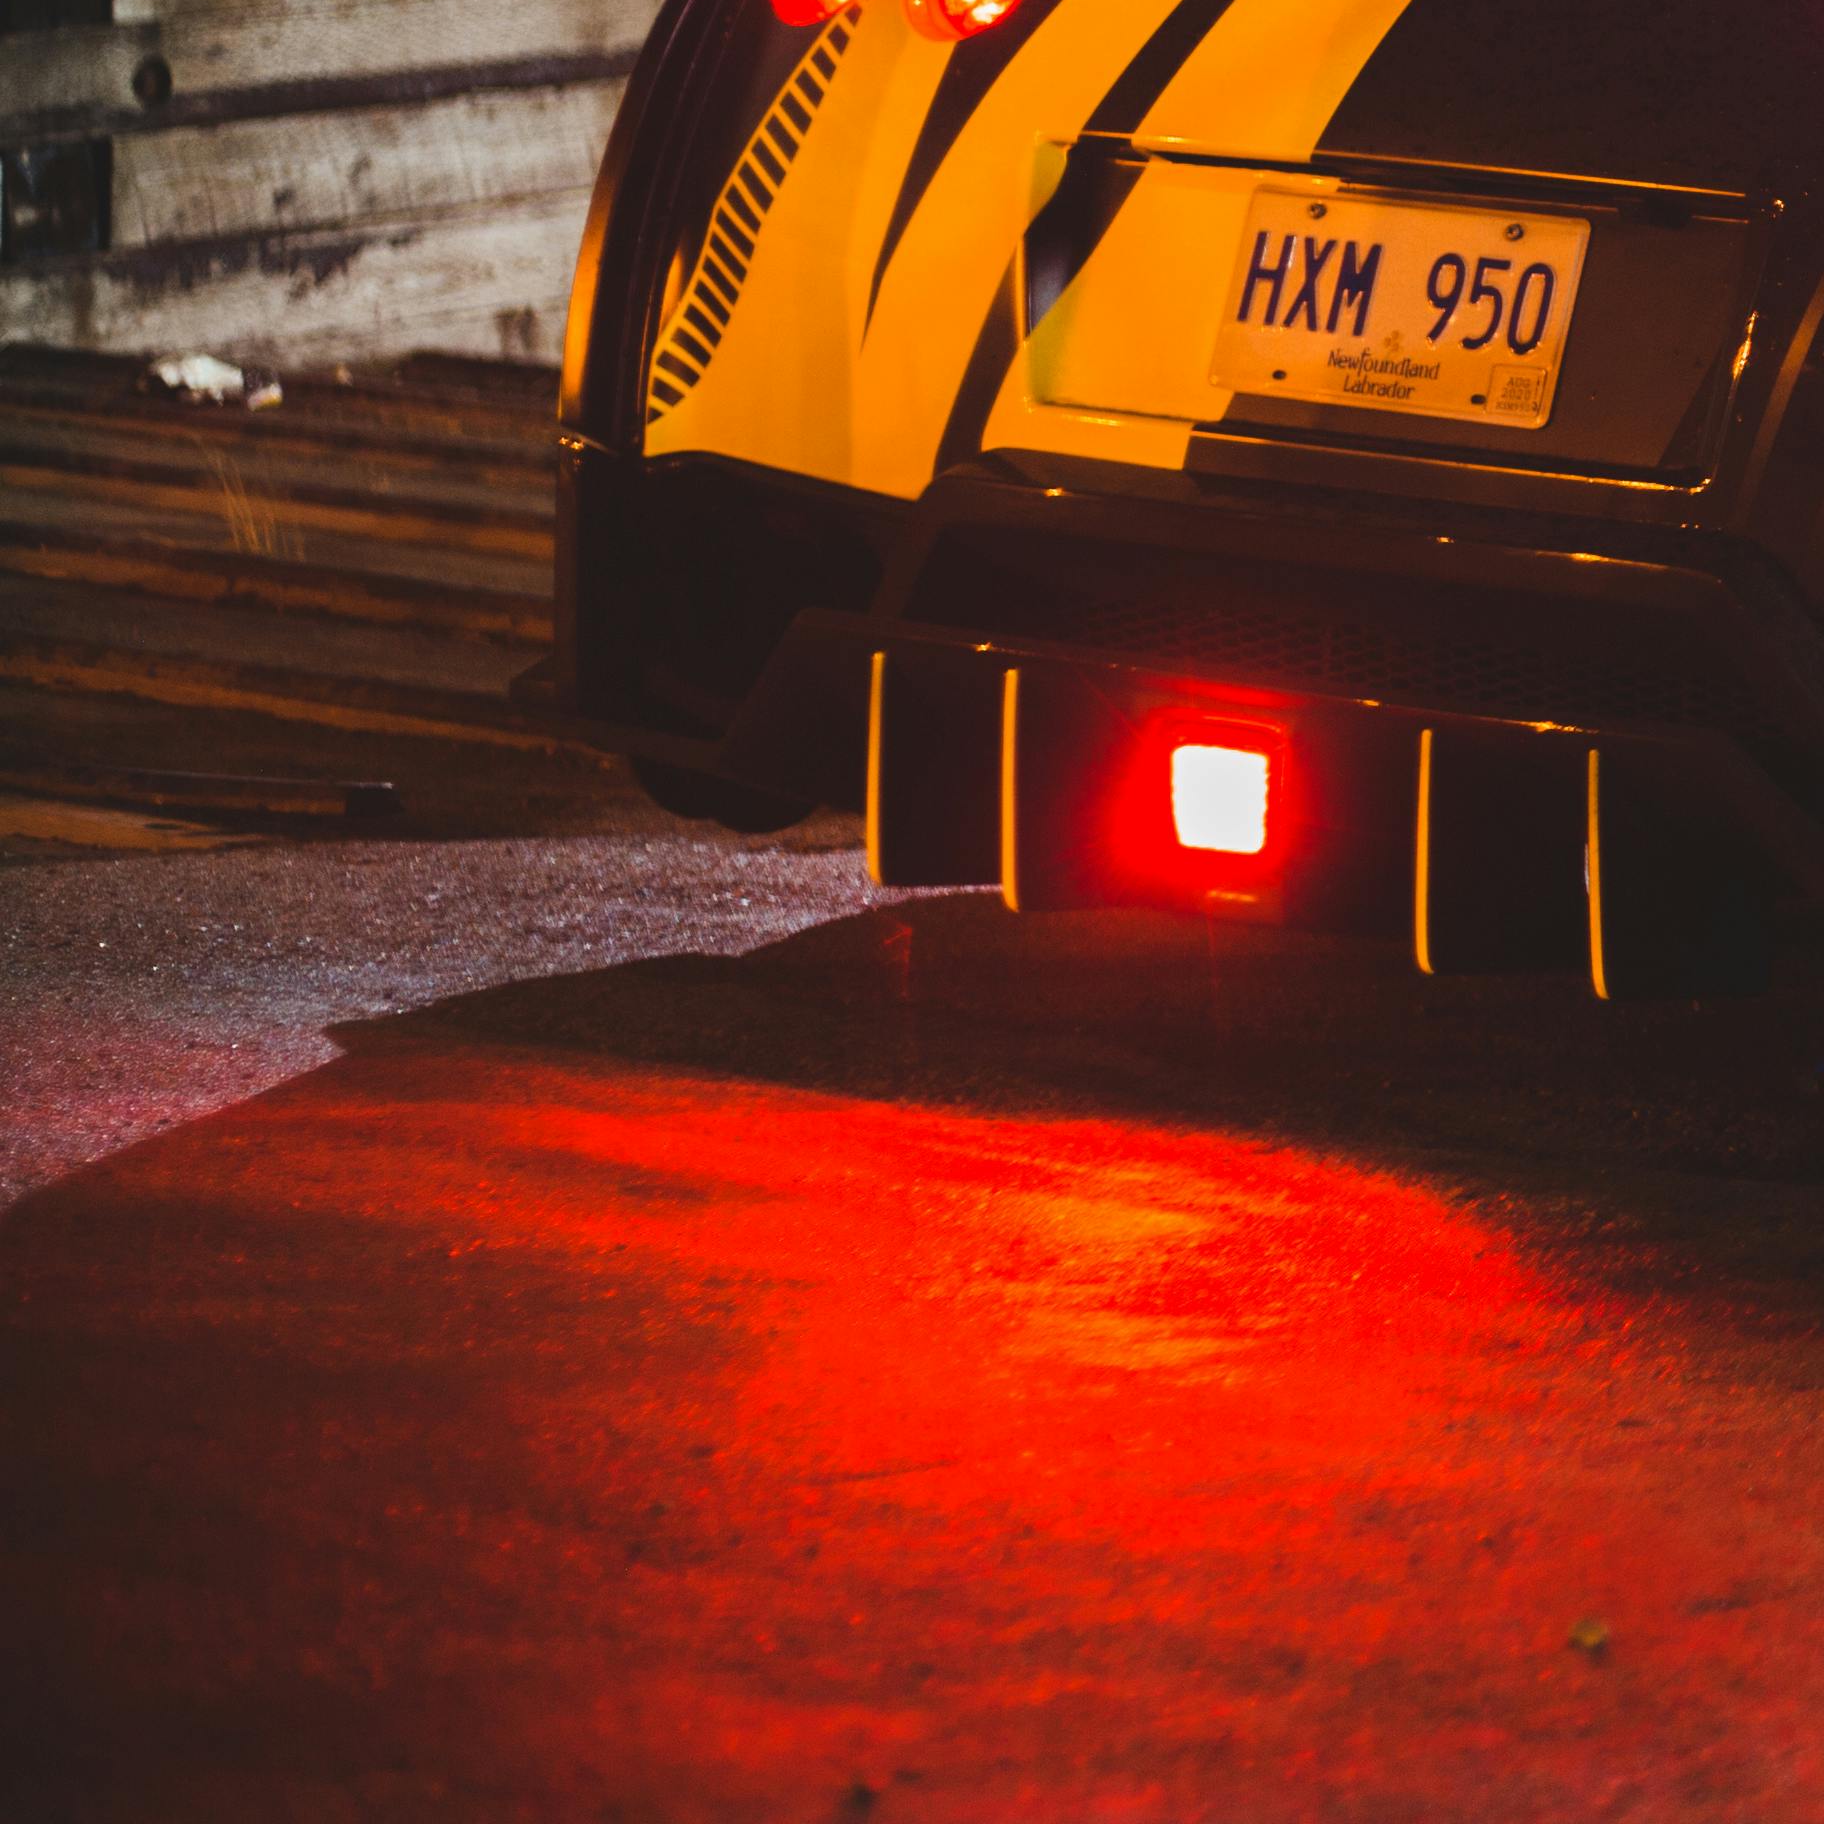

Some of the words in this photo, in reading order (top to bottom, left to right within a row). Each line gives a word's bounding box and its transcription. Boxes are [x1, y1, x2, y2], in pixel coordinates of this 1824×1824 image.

[1236, 230, 1383, 337] HXM
[1426, 252, 1556, 356] 950
[1327, 347, 1440, 381] Newfoundland
[1343, 375, 1416, 400] Labrador
